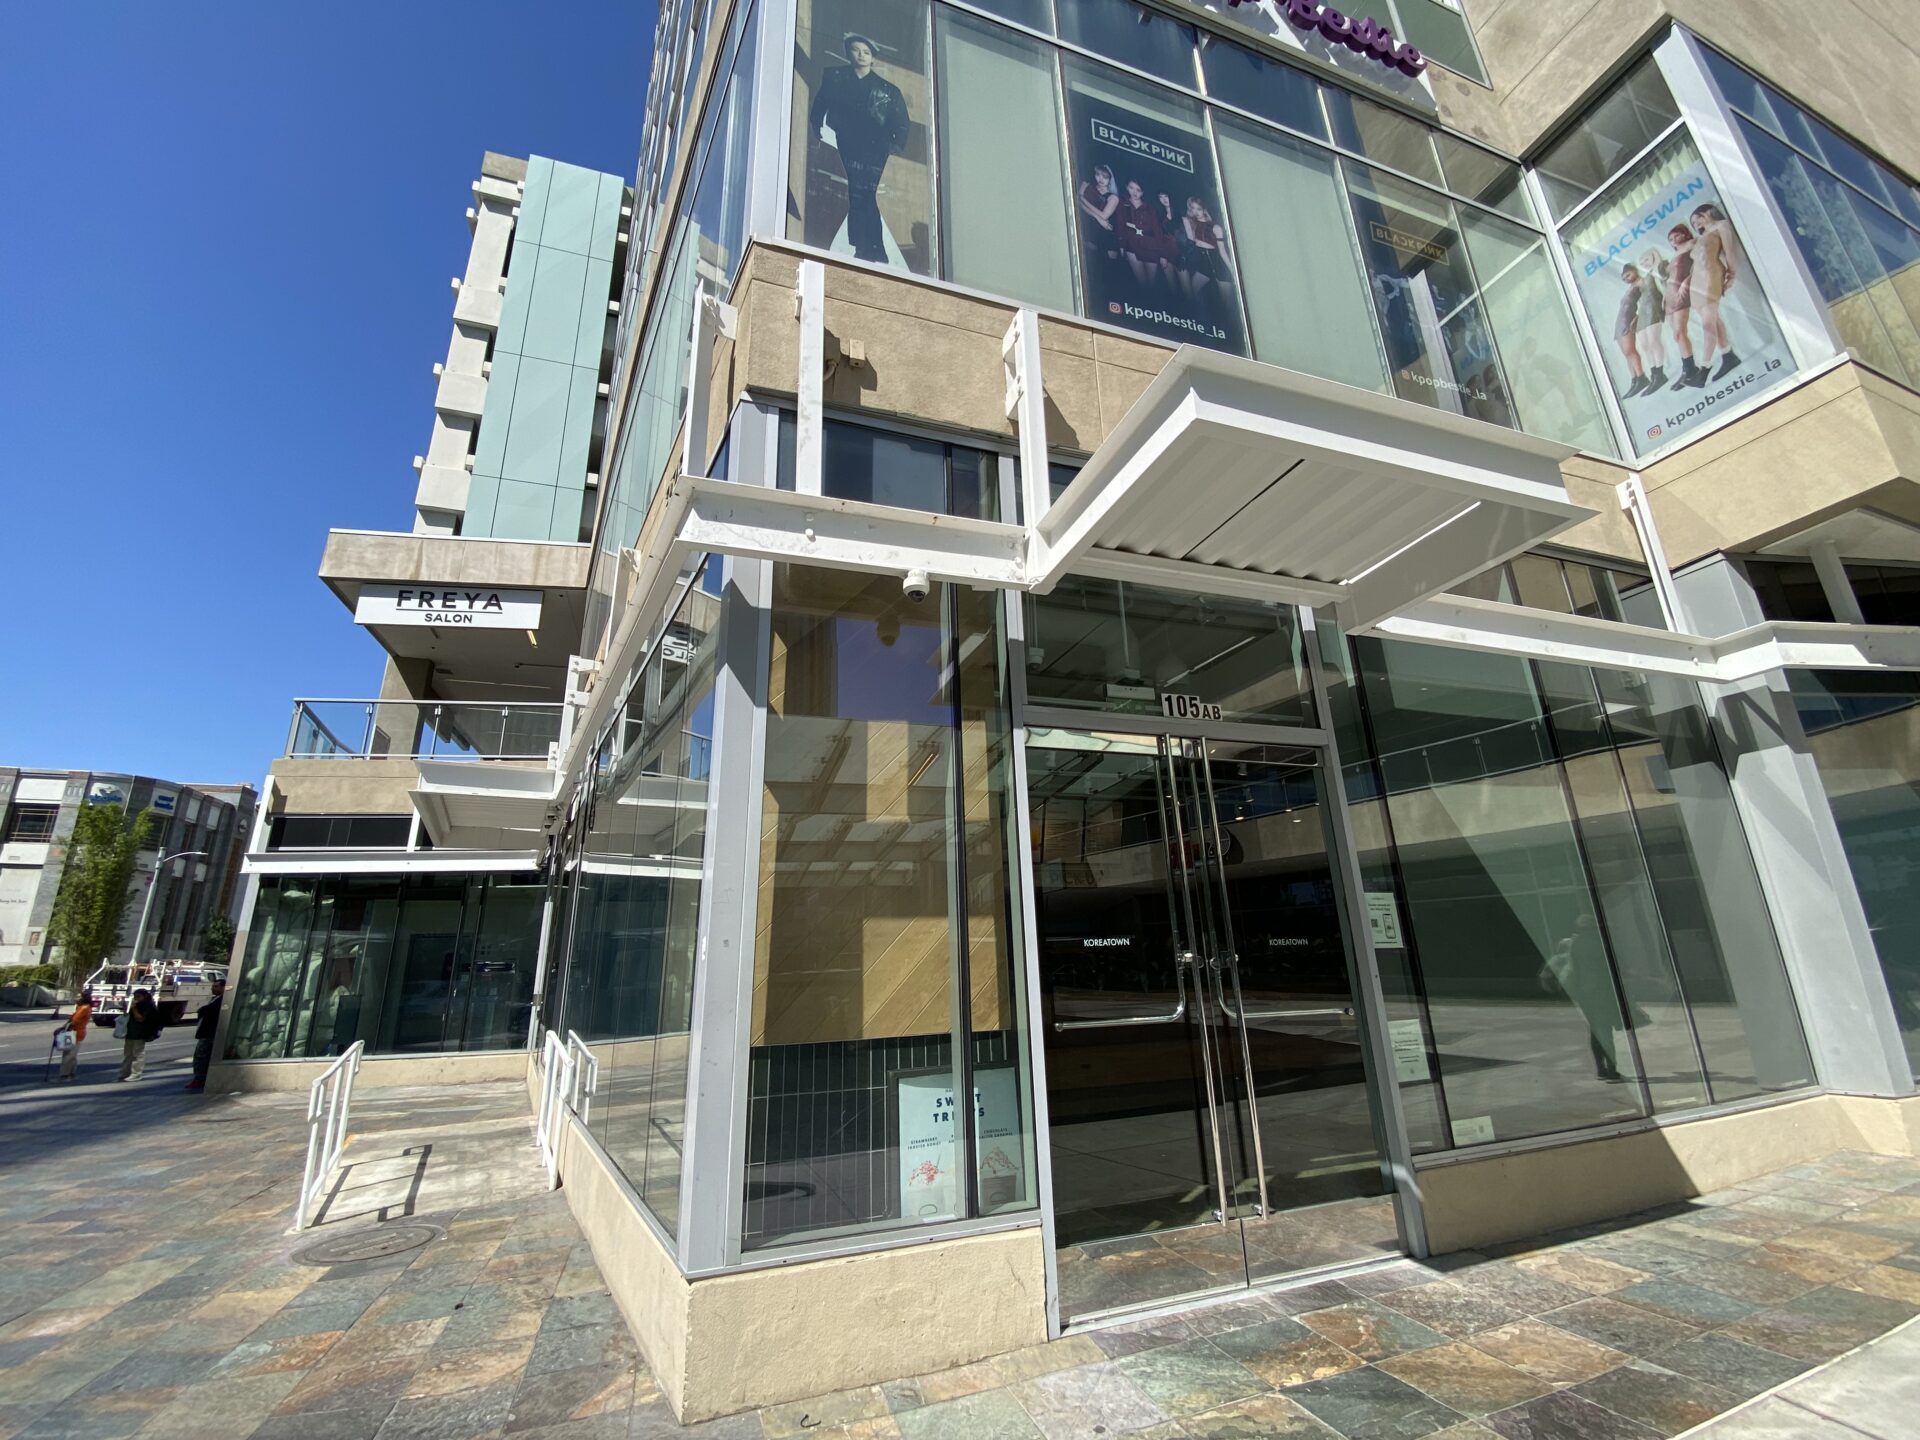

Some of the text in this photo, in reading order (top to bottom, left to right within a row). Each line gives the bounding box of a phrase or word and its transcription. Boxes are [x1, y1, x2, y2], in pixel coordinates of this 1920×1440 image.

[1584, 176, 1704, 277] BLACKSWAN
[1124, 302, 1226, 340] kpopbestie_la
[1665, 357, 1782, 428] kpopbestie_la
[397, 590, 503, 611] FREYA
[424, 613, 473, 624] SALON
[1083, 938, 1131, 947] KOREATOWN
[1268, 938, 1309, 947] KOREATOWN
[936, 1093, 982, 1108] SWT
